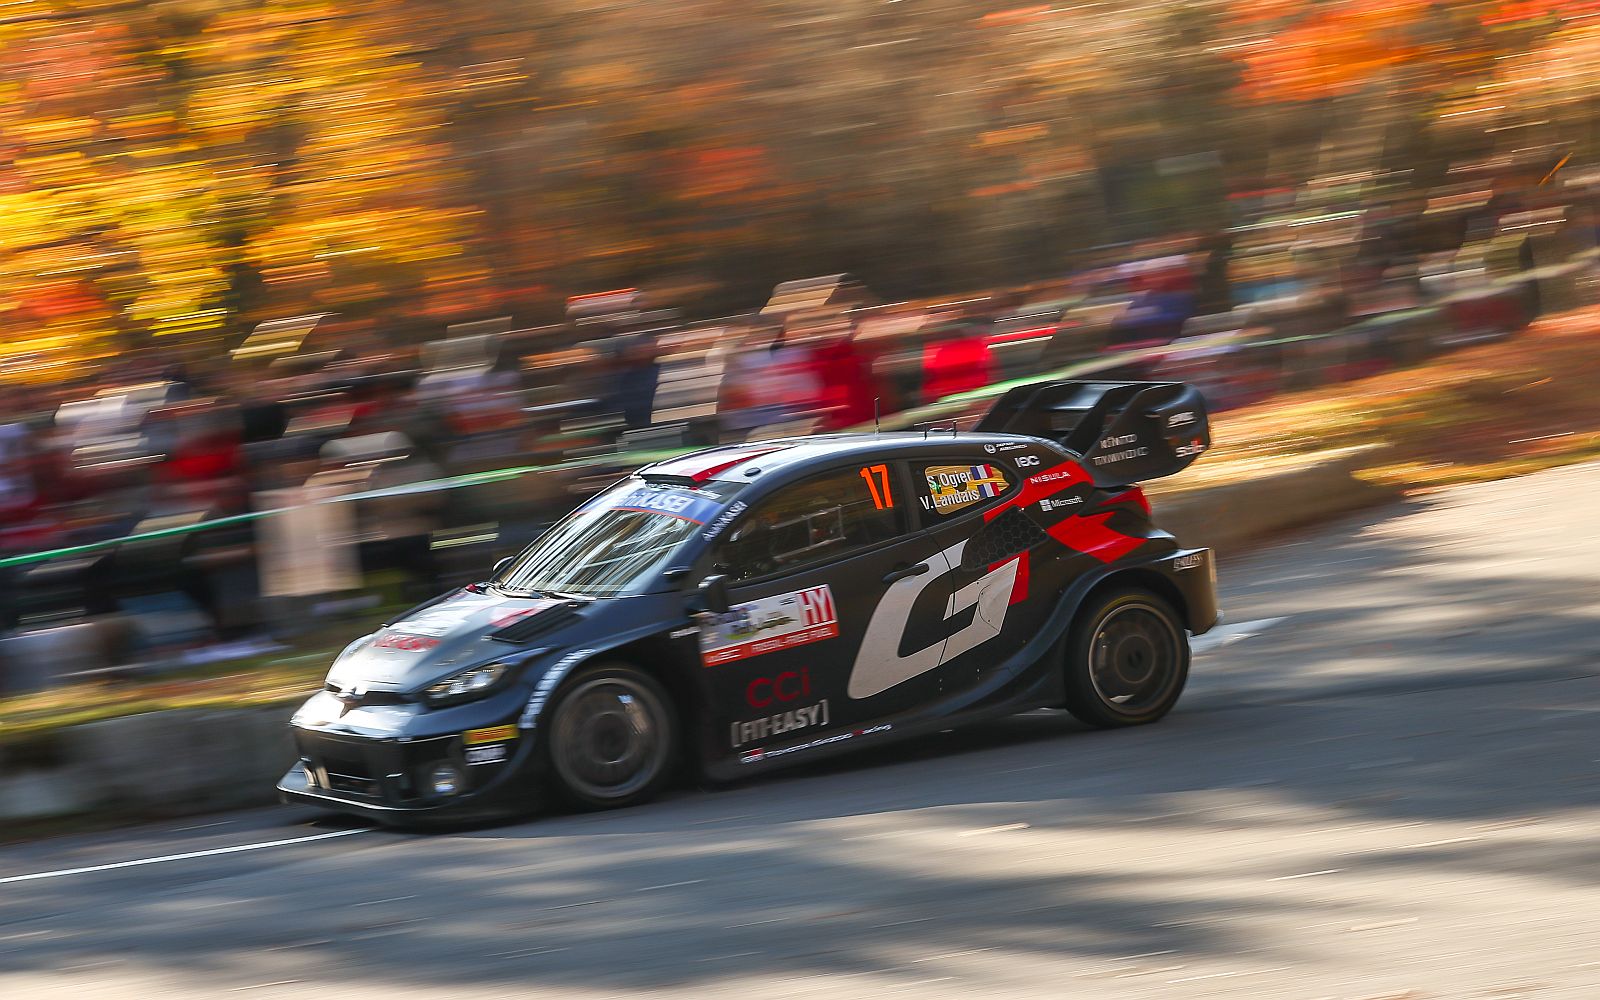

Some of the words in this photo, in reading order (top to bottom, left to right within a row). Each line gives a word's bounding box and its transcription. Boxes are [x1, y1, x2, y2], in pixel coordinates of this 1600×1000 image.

[859, 464, 894, 509] 17
[927, 471, 972, 490] S.Ogier
[1030, 471, 1071, 484] NISULA
[920, 489, 980, 510] V.Landais
